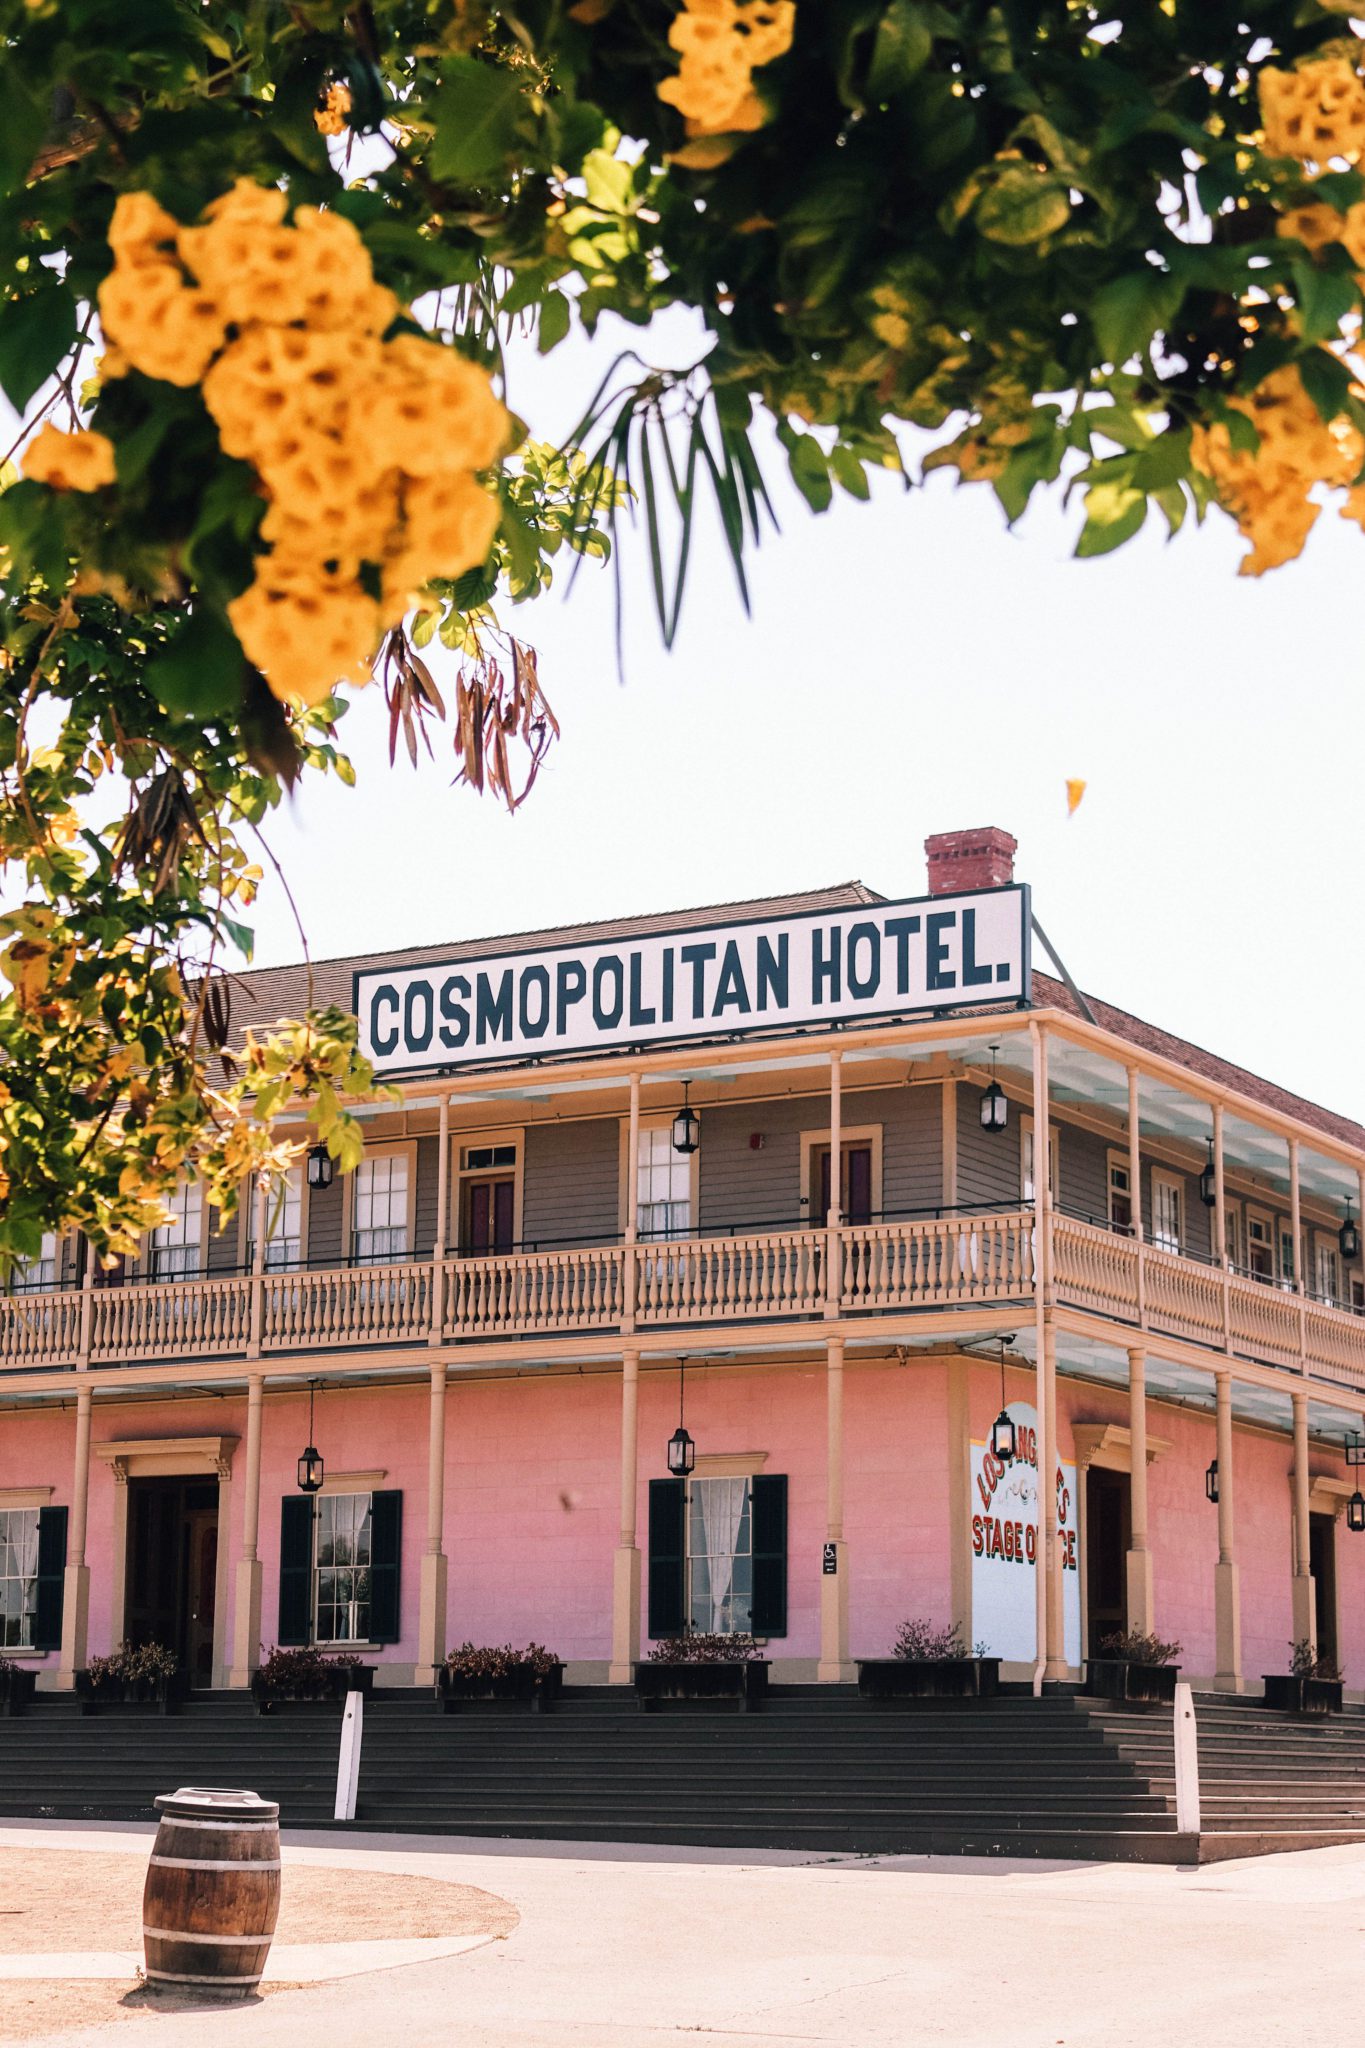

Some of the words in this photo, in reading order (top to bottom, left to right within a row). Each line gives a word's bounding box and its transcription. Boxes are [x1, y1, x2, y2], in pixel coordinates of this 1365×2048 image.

[370, 932, 789, 1057] COSMOPOLITAN
[812, 908, 1010, 1004] HOTEL.
[1008, 1425, 1071, 1525] NGES
[972, 1514, 1024, 1564] STAGE
[1025, 1523, 1077, 1571] OCE
